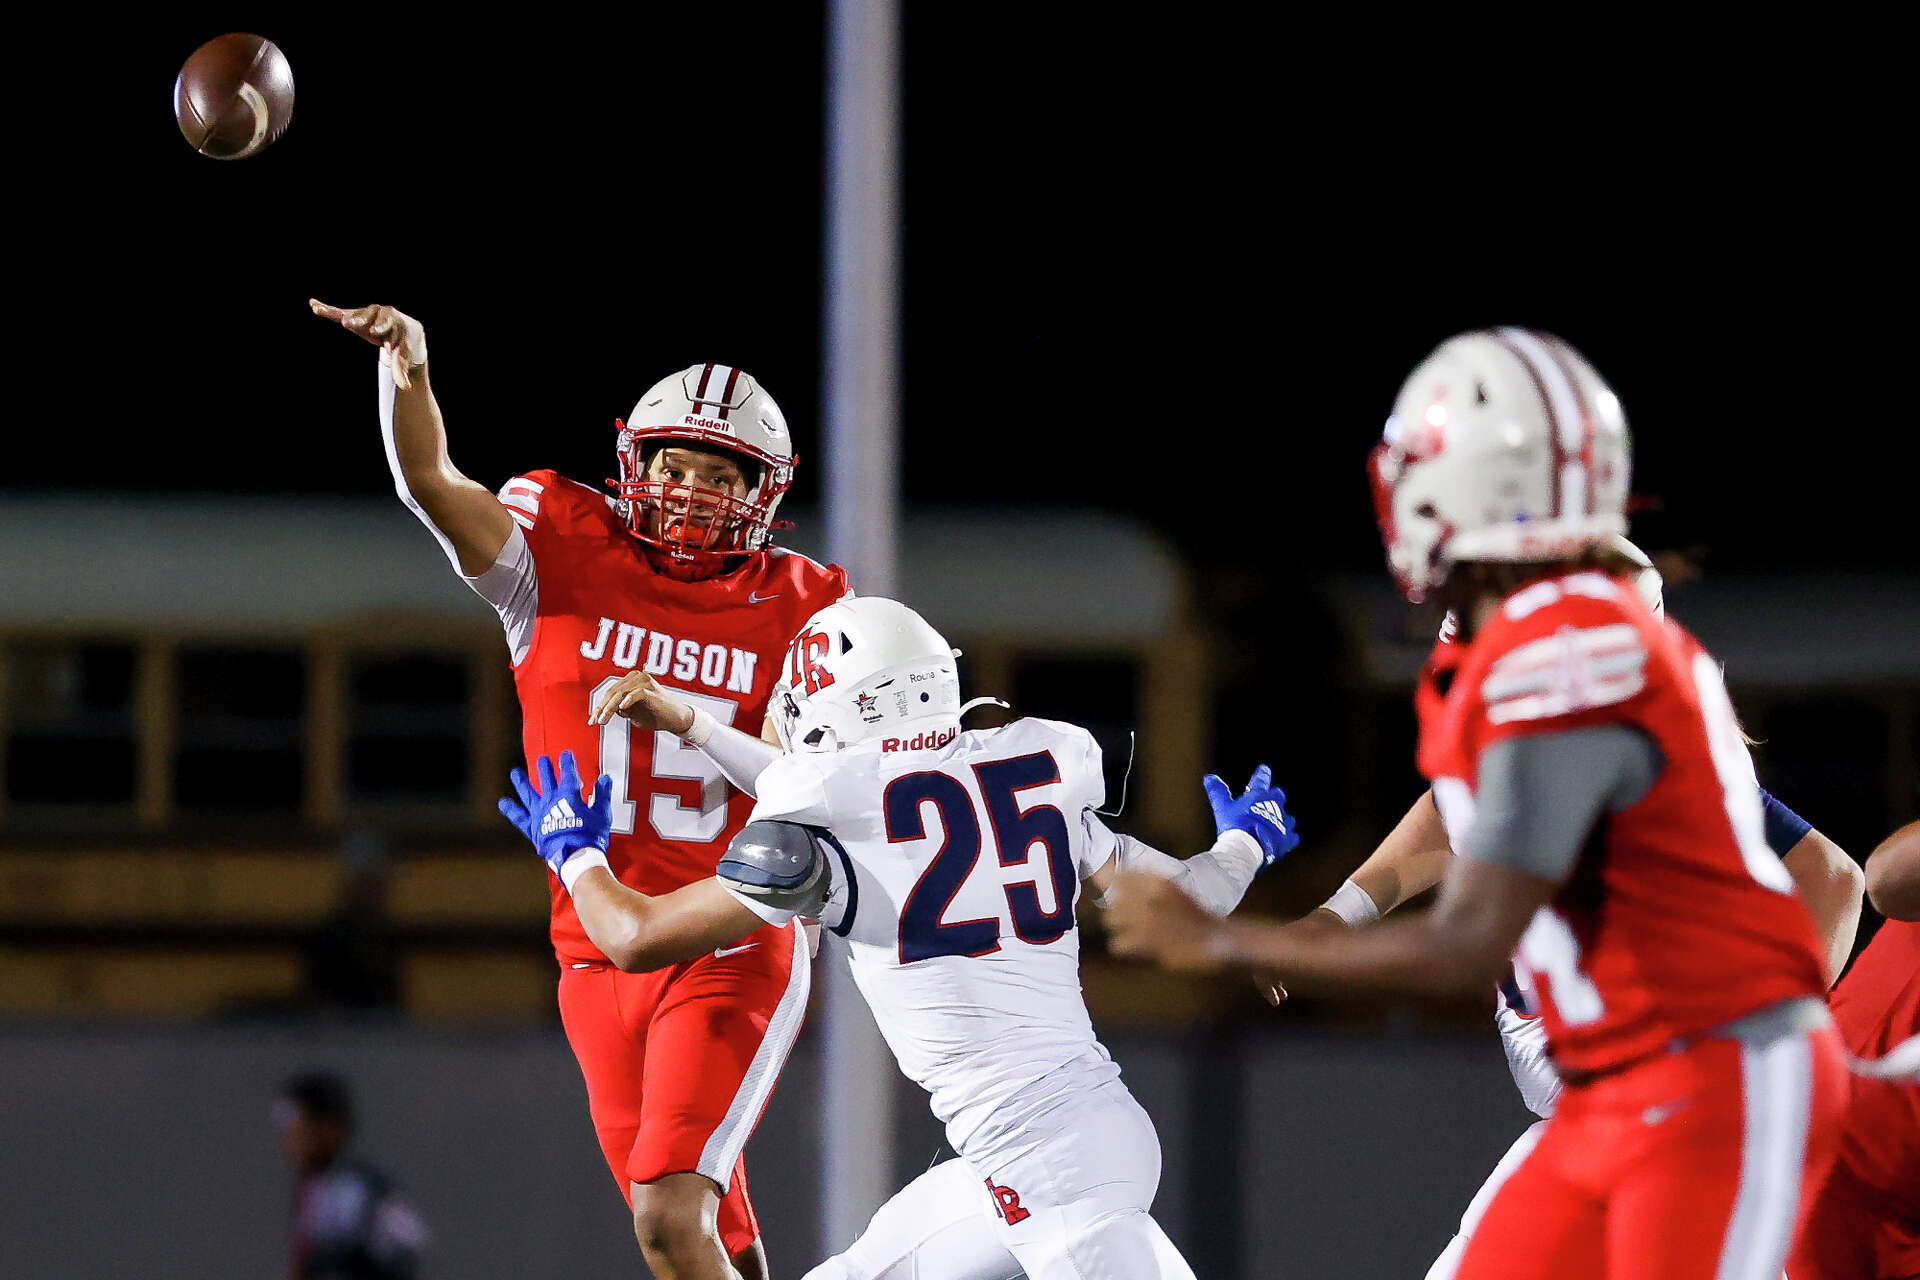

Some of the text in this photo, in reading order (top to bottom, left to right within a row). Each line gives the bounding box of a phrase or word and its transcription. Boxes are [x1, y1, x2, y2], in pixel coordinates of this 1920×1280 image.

[684, 415, 730, 432] Riddell
[579, 616, 758, 694] JUDSON
[588, 675, 739, 843] 15
[882, 727, 956, 753] Riddell
[882, 749, 1077, 965] 25
